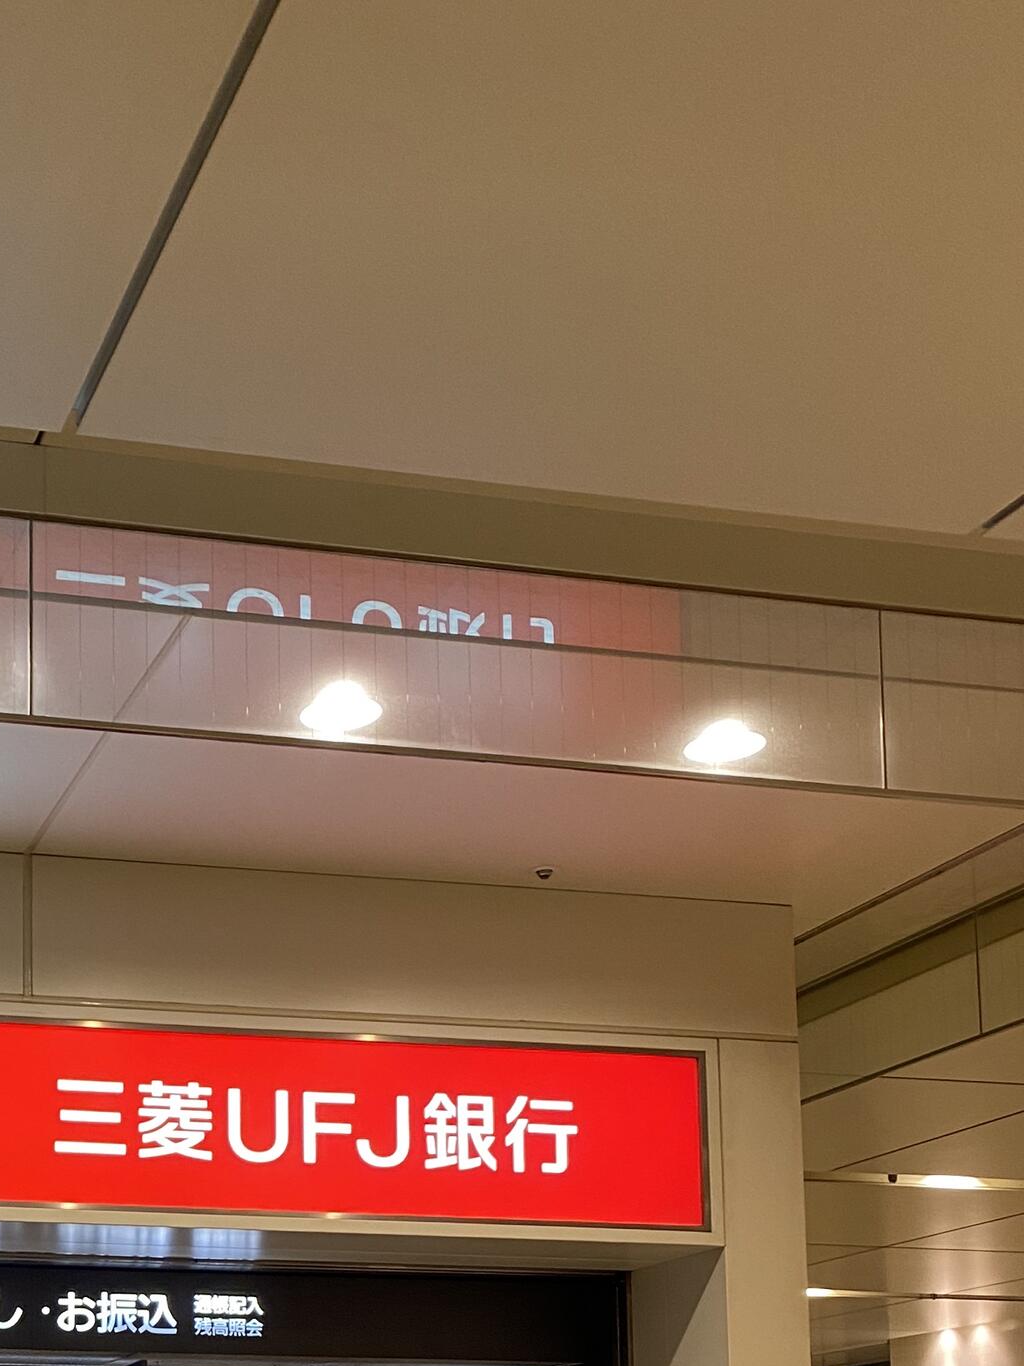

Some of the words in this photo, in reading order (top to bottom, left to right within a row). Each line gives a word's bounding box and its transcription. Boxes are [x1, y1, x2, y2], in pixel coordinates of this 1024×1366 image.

[54, 1079, 578, 1174] 三菱UFJ銀行
[194, 1317, 264, 1338] 残高照会
